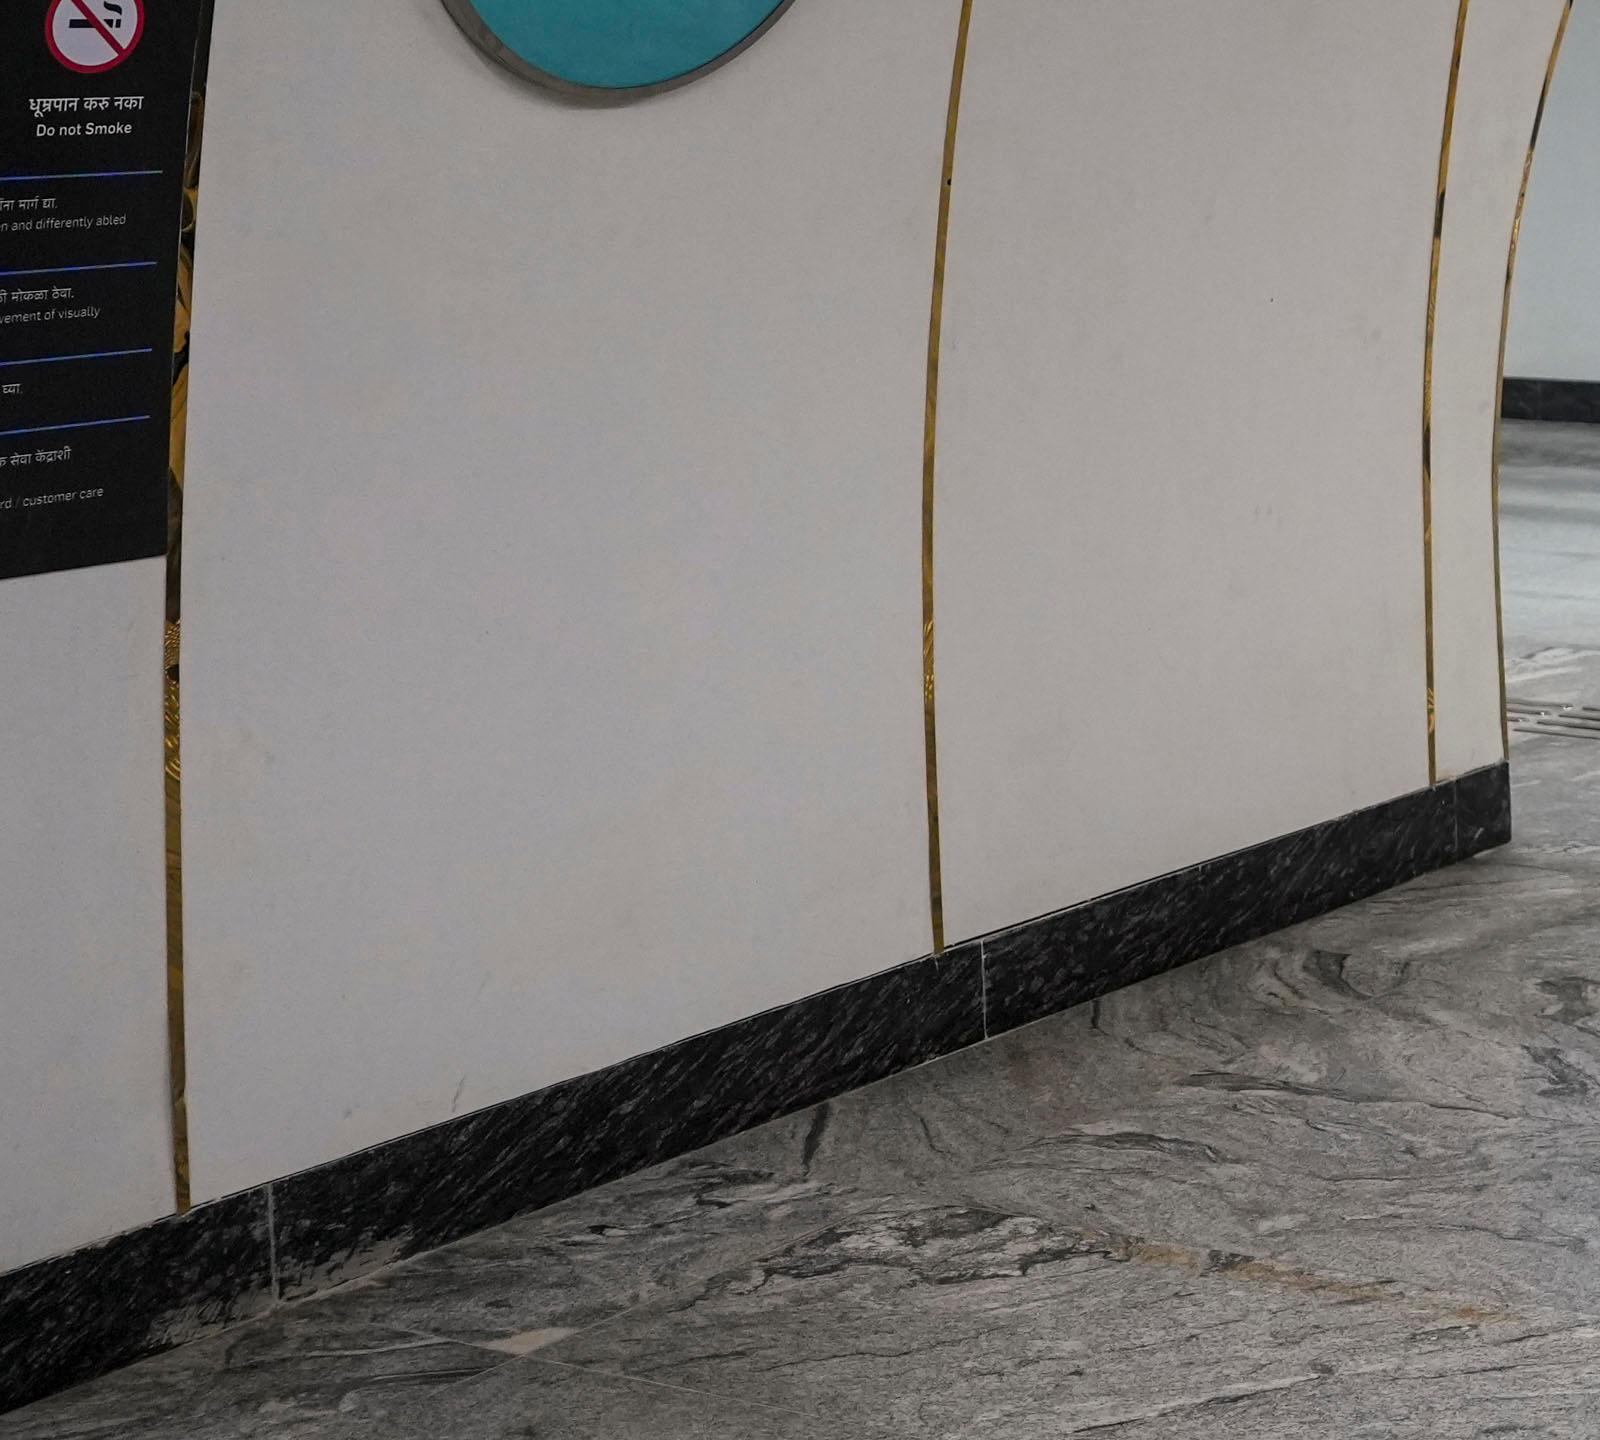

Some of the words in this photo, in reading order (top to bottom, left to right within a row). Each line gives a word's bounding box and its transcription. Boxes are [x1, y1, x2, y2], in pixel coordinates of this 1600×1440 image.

[28, 97, 80, 118] धूम्रपान
[113, 96, 144, 111] नका
[36, 124, 55, 137] Do
[59, 123, 81, 136] not
[85, 122, 132, 135] Smoke
[11, 220, 33, 232] and
[36, 216, 93, 231] differently
[95, 214, 127, 227] abled
[44, 308, 56, 321] of
[58, 306, 101, 320] visually
[10, 452, 32, 467] सेवा
[22, 491, 77, 509] customer
[79, 487, 104, 501] care
